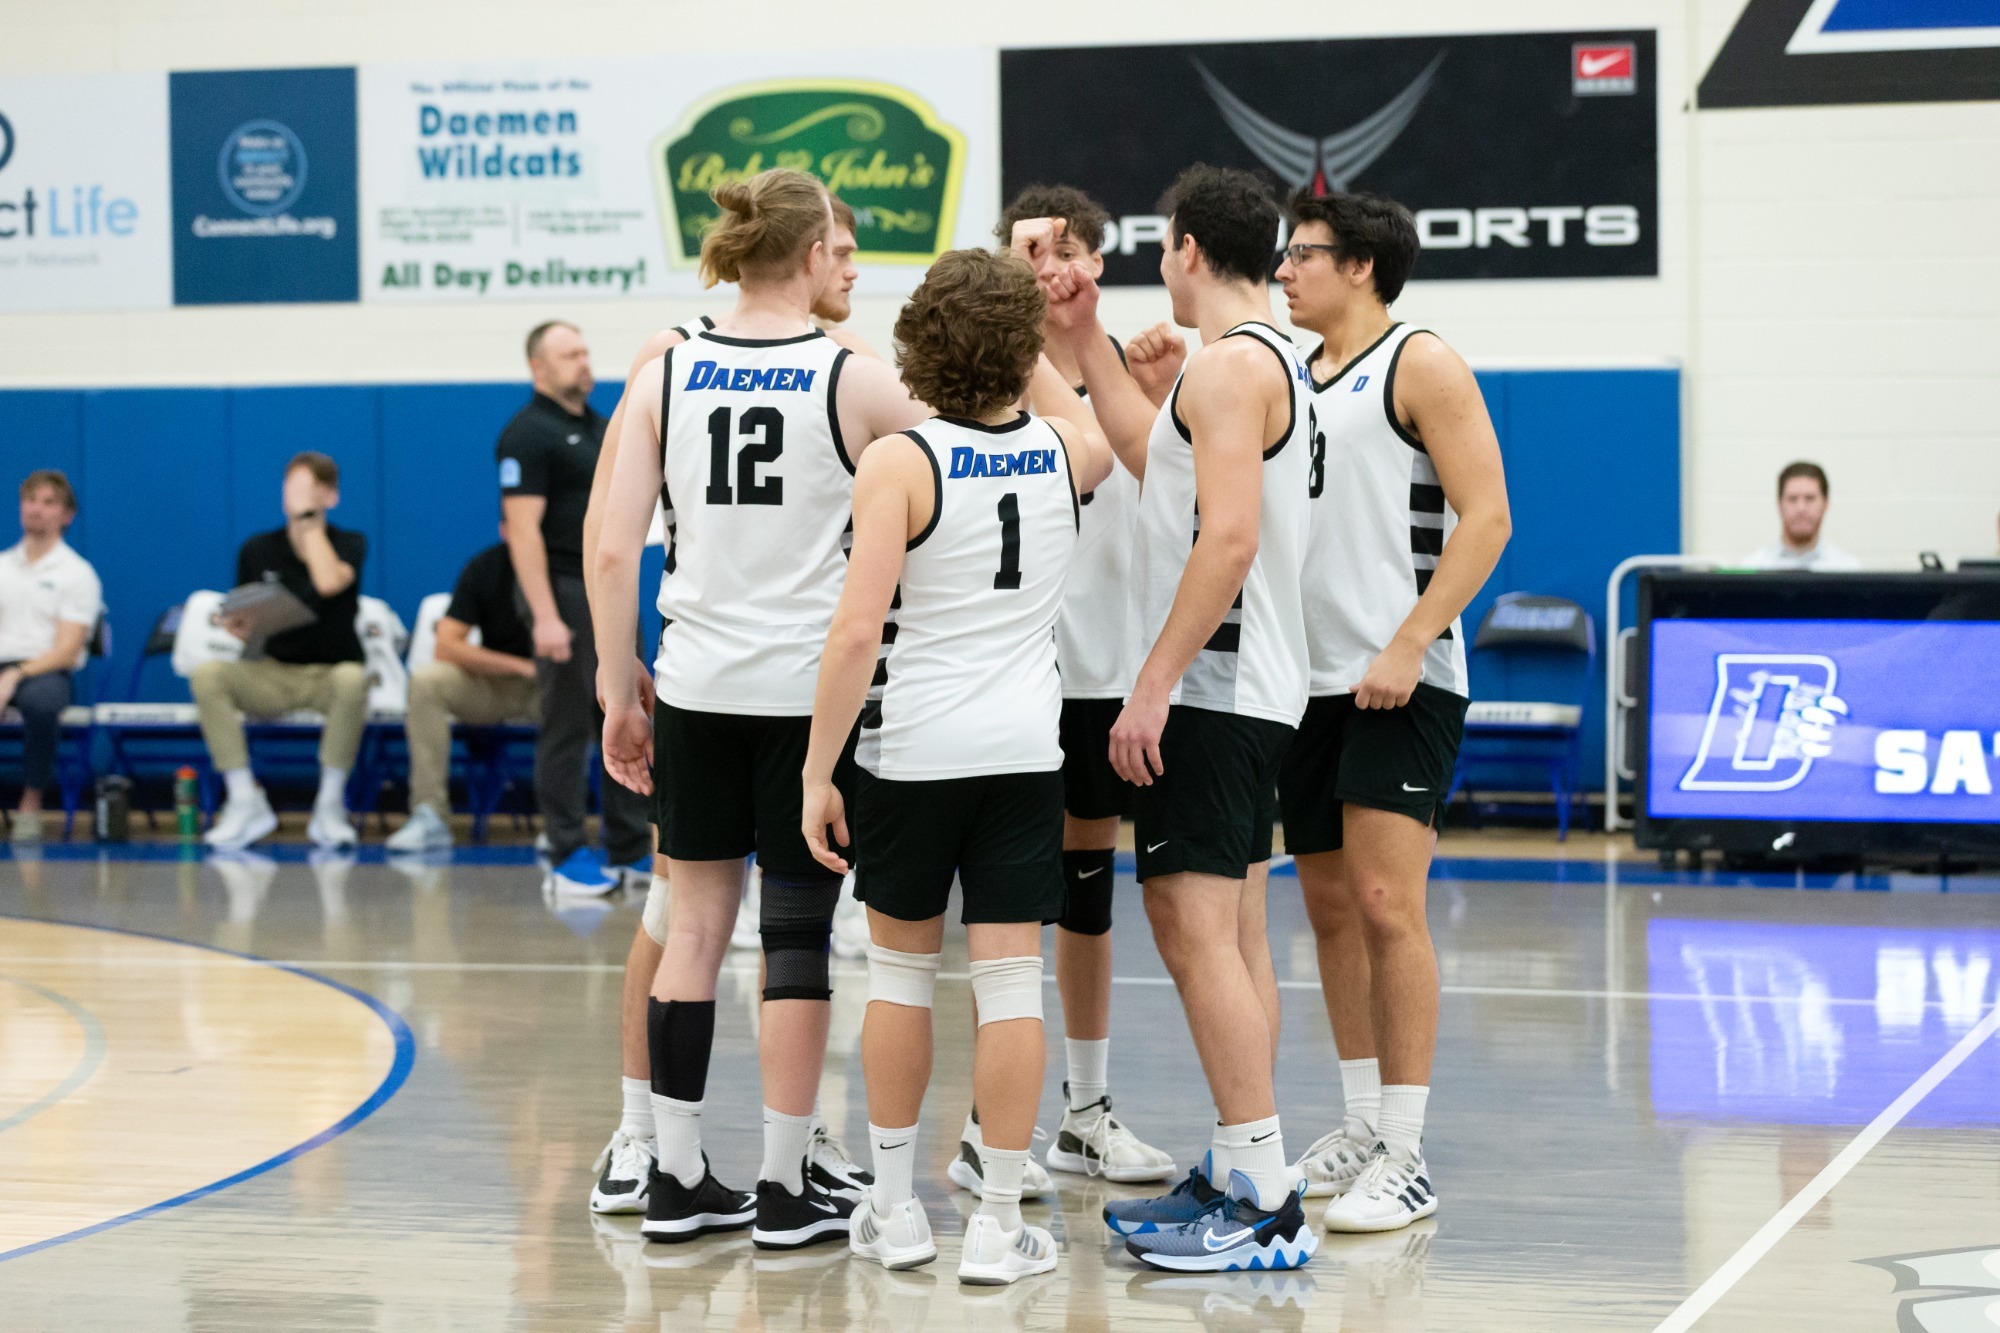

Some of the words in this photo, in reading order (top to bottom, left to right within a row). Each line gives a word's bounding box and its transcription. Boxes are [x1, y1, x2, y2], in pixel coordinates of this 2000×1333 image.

[419, 104, 578, 137] Daemen
[417, 144, 582, 179] Wildcats
[1412, 205, 1640, 250] ORTS
[381, 262, 421, 288] All
[433, 262, 492, 293] Day
[505, 257, 647, 293] Delivery!
[706, 406, 785, 505] 12
[993, 492, 1022, 590] 1
[1874, 729, 2000, 795] SA
